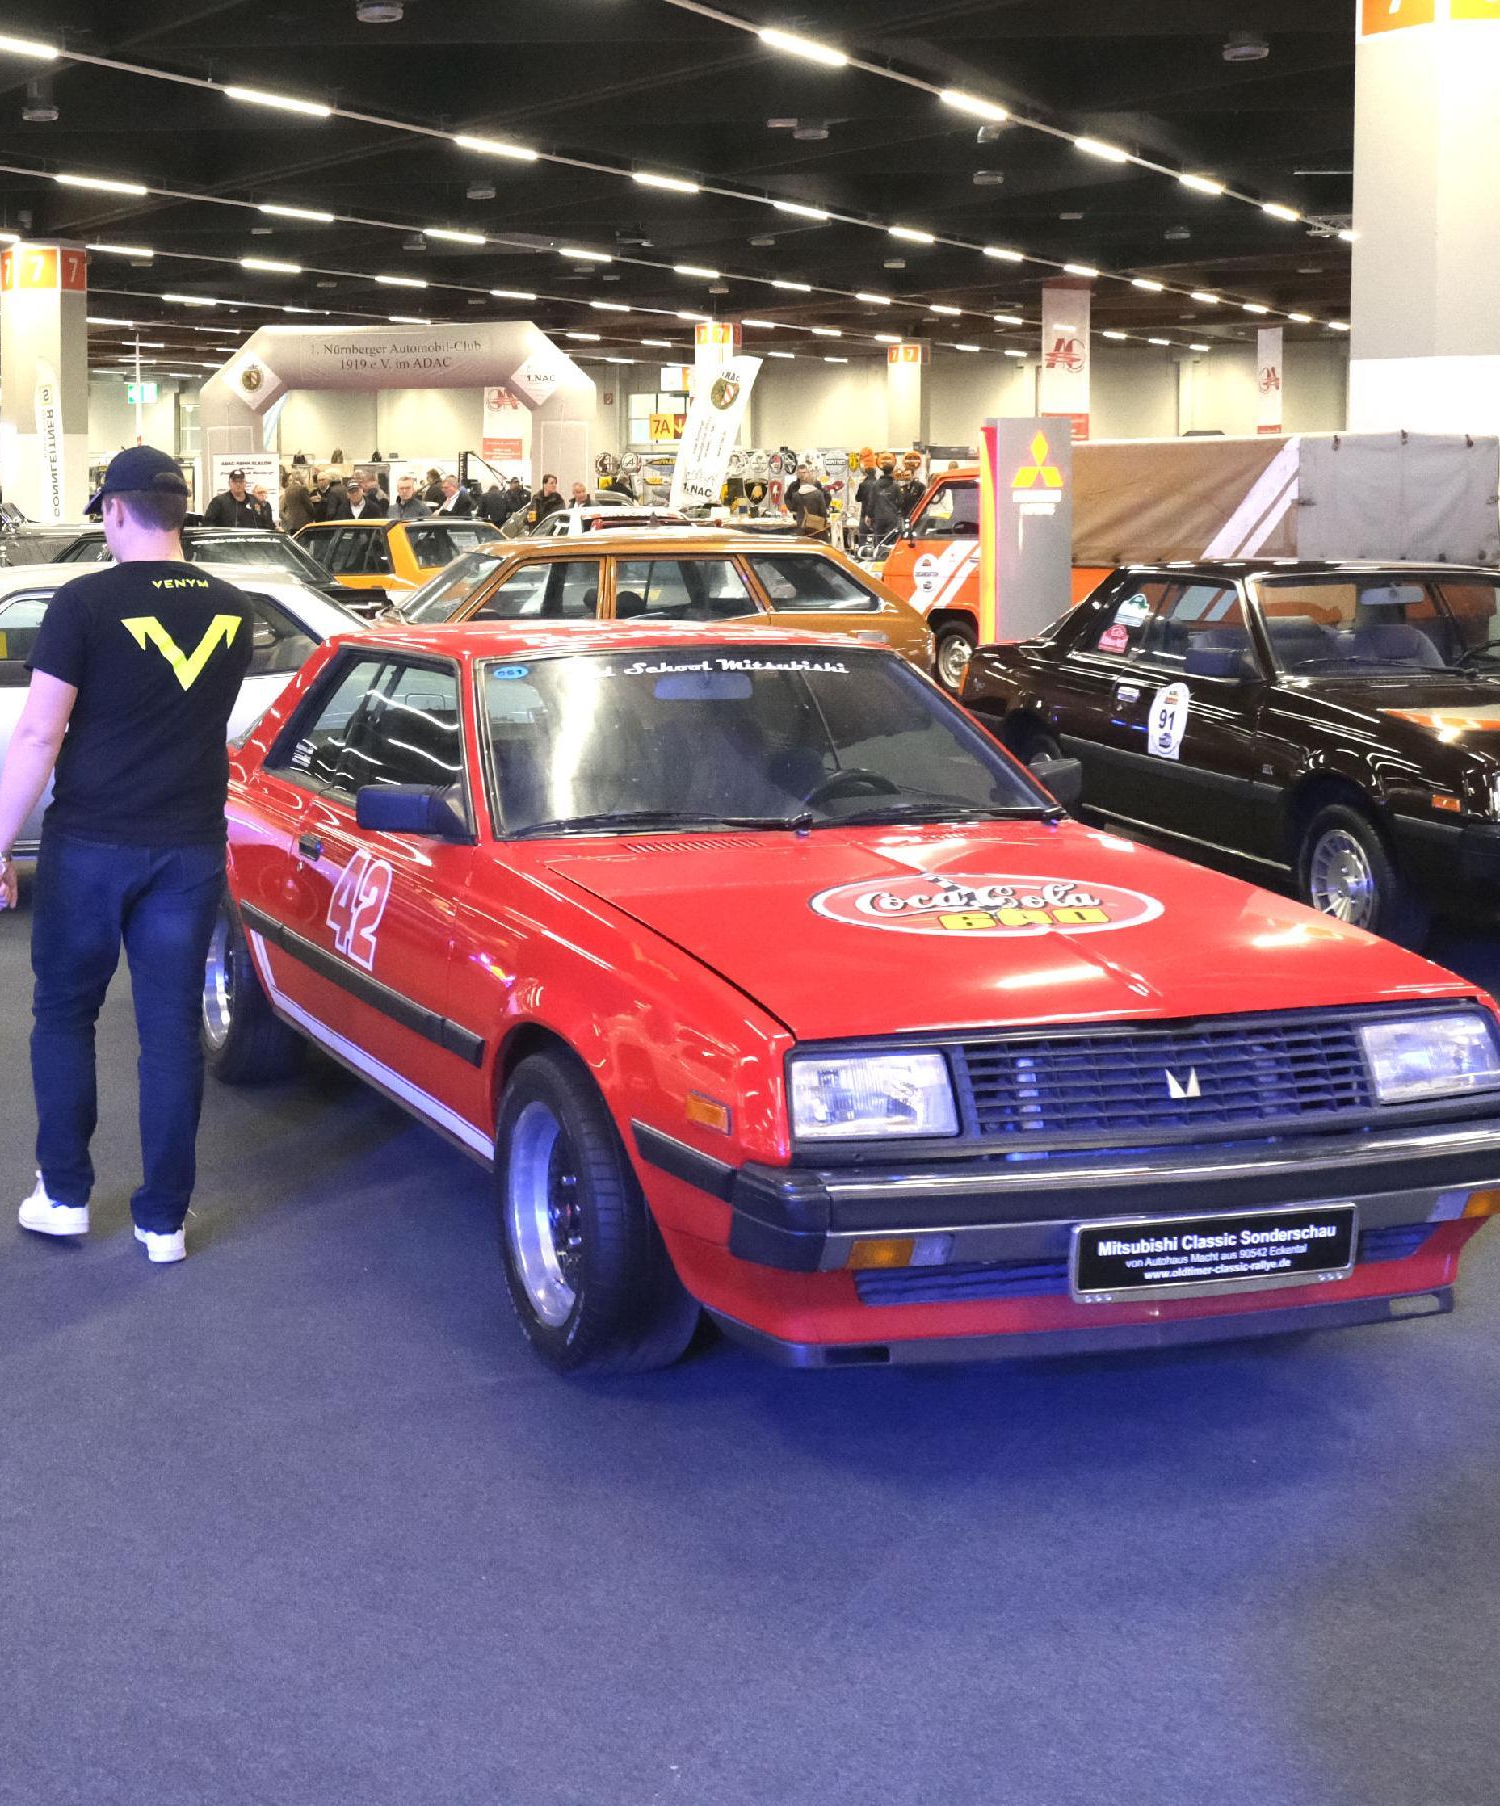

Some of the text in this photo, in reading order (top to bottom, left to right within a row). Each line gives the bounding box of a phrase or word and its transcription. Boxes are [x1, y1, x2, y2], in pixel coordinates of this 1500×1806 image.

[30, 256, 45, 282] 7
[68, 257, 78, 284] 7
[323, 343, 388, 357] Nürnberger
[390, 340, 482, 354] Automobil-Club
[340, 359, 367, 370] 1919
[412, 357, 452, 369] ADAC
[652, 419, 671, 435] 7A
[683, 482, 713, 498] 1.NAC
[152, 578, 209, 589] VENYM
[623, 661, 713, 675] School
[716, 659, 850, 674] Mitsubishi
[1158, 709, 1175, 731] 91
[326, 849, 393, 972] 42
[1097, 1224, 1337, 1257] Mitsubishi Classic Sonderschau
[1124, 1243, 1308, 1268] von Autohaus Macht aus 90542 Eckental
[1144, 1258, 1292, 1280] www.oldtimer-classic-rallye.de
